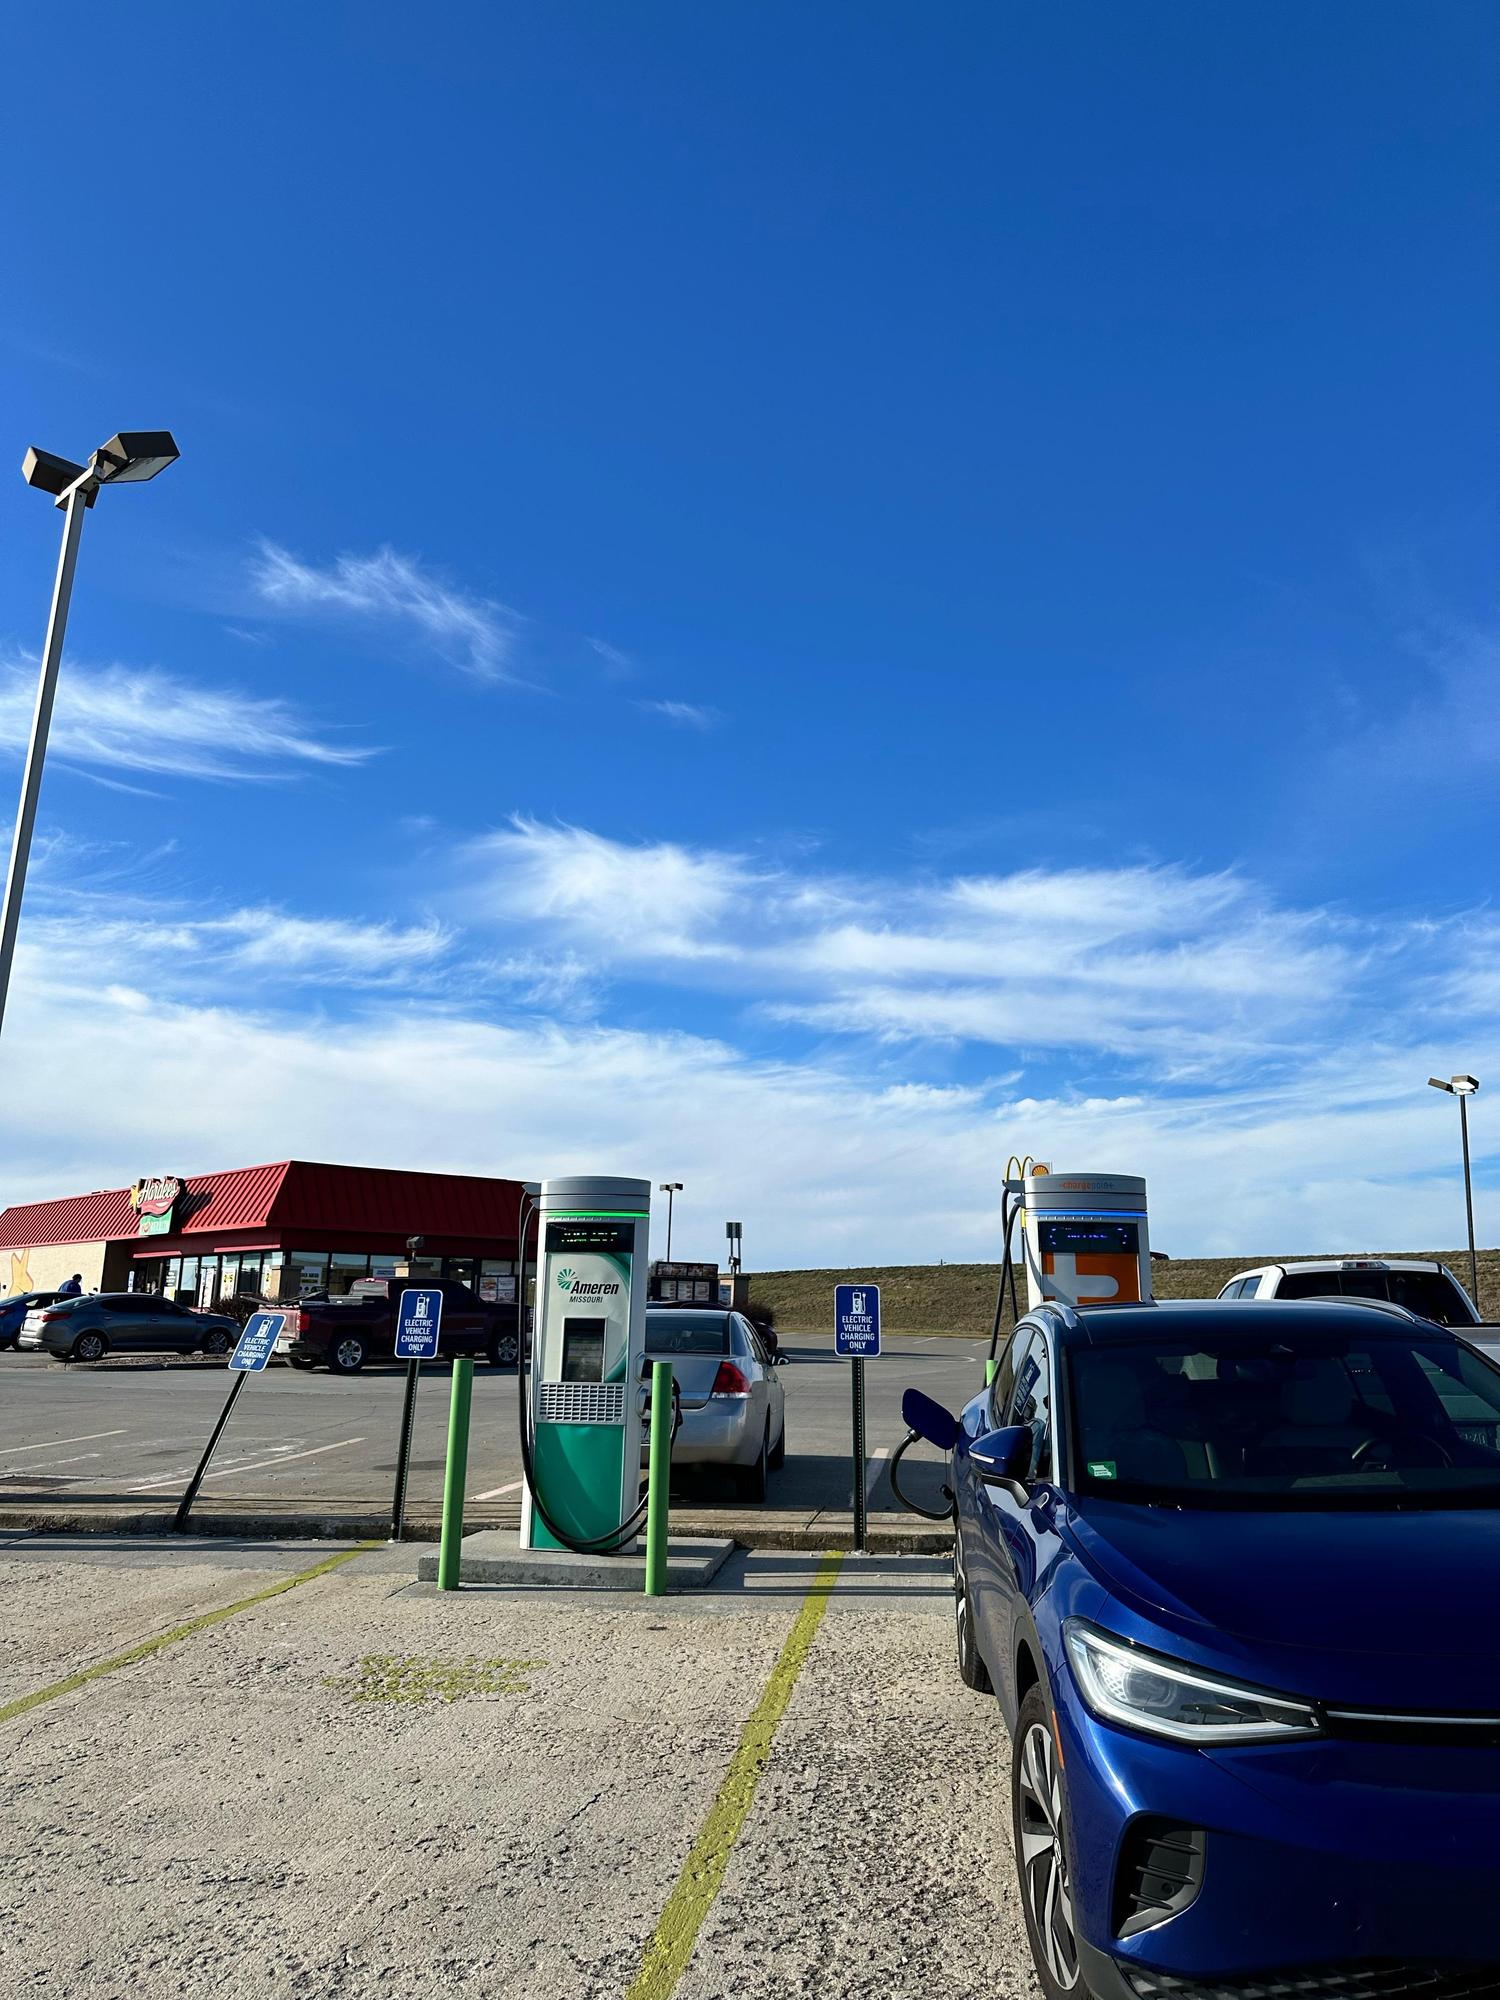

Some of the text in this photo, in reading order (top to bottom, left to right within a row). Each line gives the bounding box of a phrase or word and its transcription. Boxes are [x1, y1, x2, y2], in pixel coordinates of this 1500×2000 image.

[570, 1280, 620, 1295] Ameren
[569, 1296, 603, 1304] MISSOURI
[404, 1319, 433, 1327] ELECTRIC
[841, 1315, 873, 1324] ELECTRIC
[405, 1327, 431, 1335] VEHICLE
[843, 1324, 872, 1332] VEHICLE
[401, 1335, 433, 1343] CHARGING
[840, 1332, 875, 1341] CHARGING
[244, 1337, 270, 1345] ELECTRIC
[849, 1341, 867, 1349] ONLY
[243, 1344, 266, 1352] VEHICLE
[408, 1343, 424, 1351] ONLY
[237, 1351, 266, 1359] CHARGING
